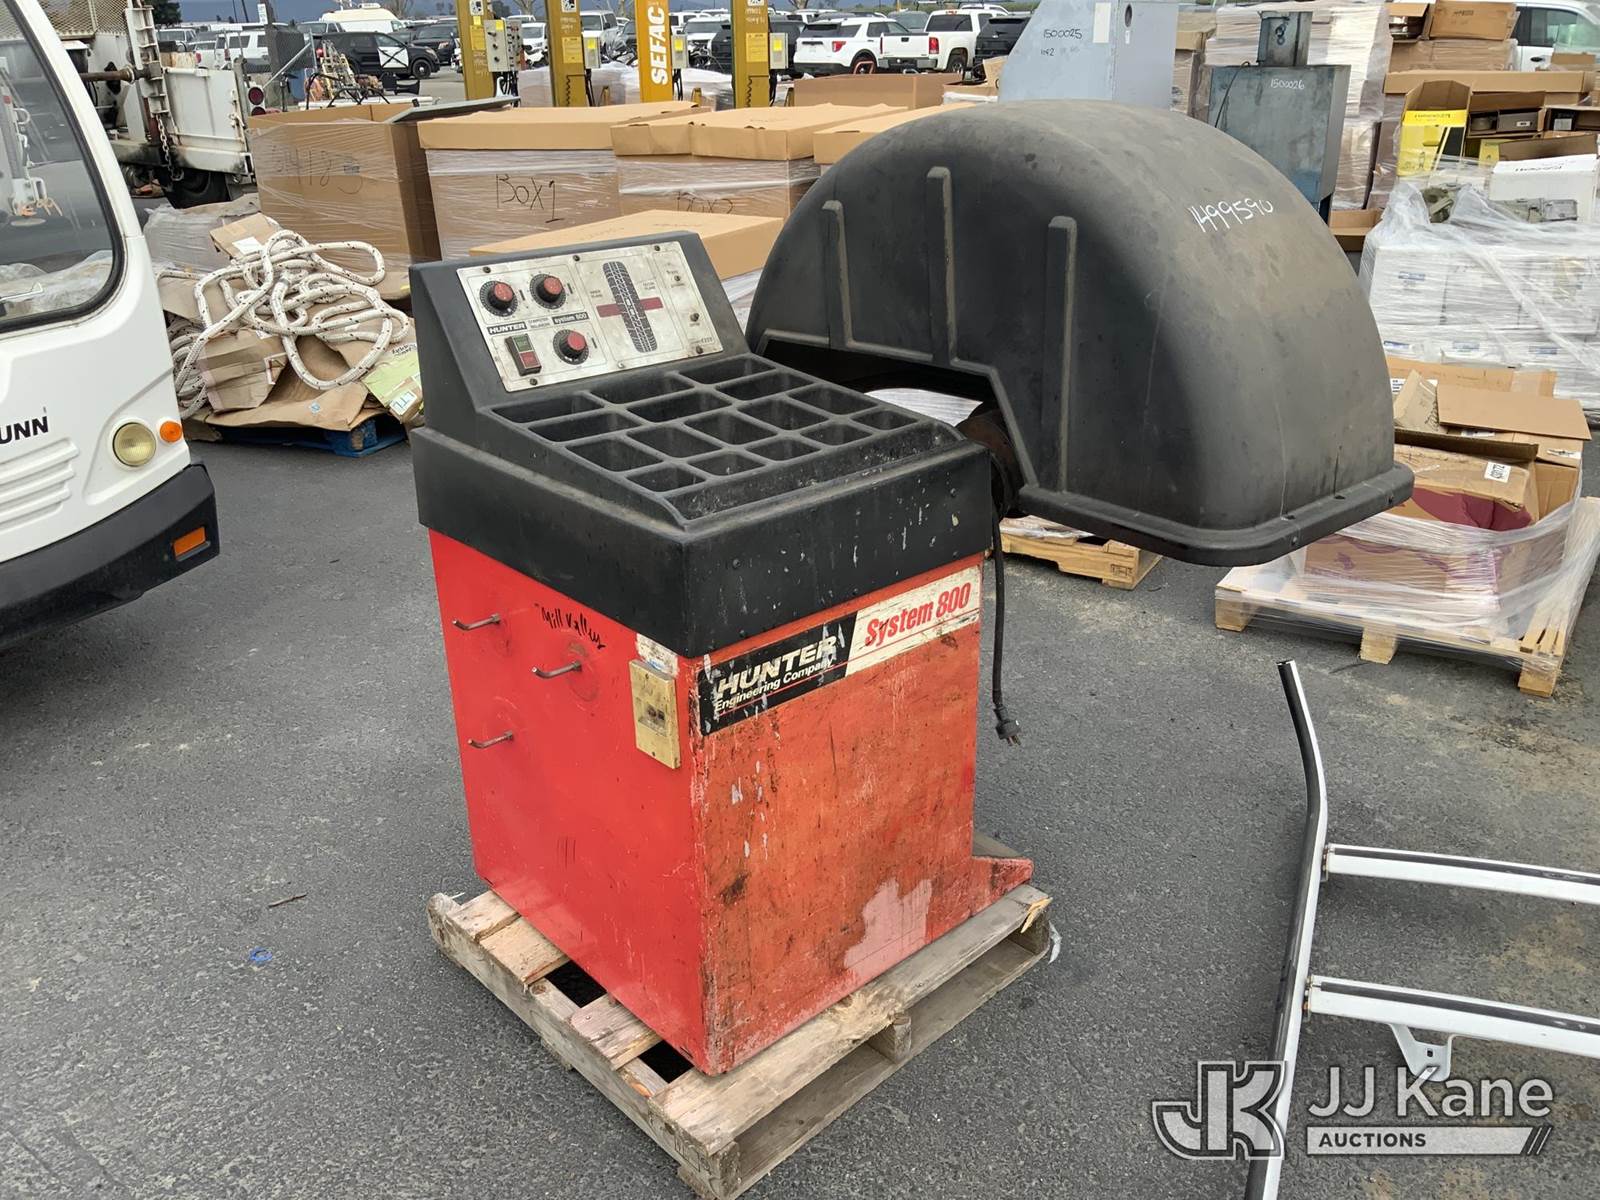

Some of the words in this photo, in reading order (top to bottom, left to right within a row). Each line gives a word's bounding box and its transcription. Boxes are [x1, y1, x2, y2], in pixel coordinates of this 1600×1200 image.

[647, 6, 669, 86] SEFAC
[1186, 197, 1274, 233] 1499590
[488, 323, 526, 335] HUNTER
[864, 601, 934, 648] System
[935, 582, 972, 618] 800
[714, 678, 781, 712] Engineering
[783, 658, 834, 684] Company
[716, 635, 838, 699] HUNTER
